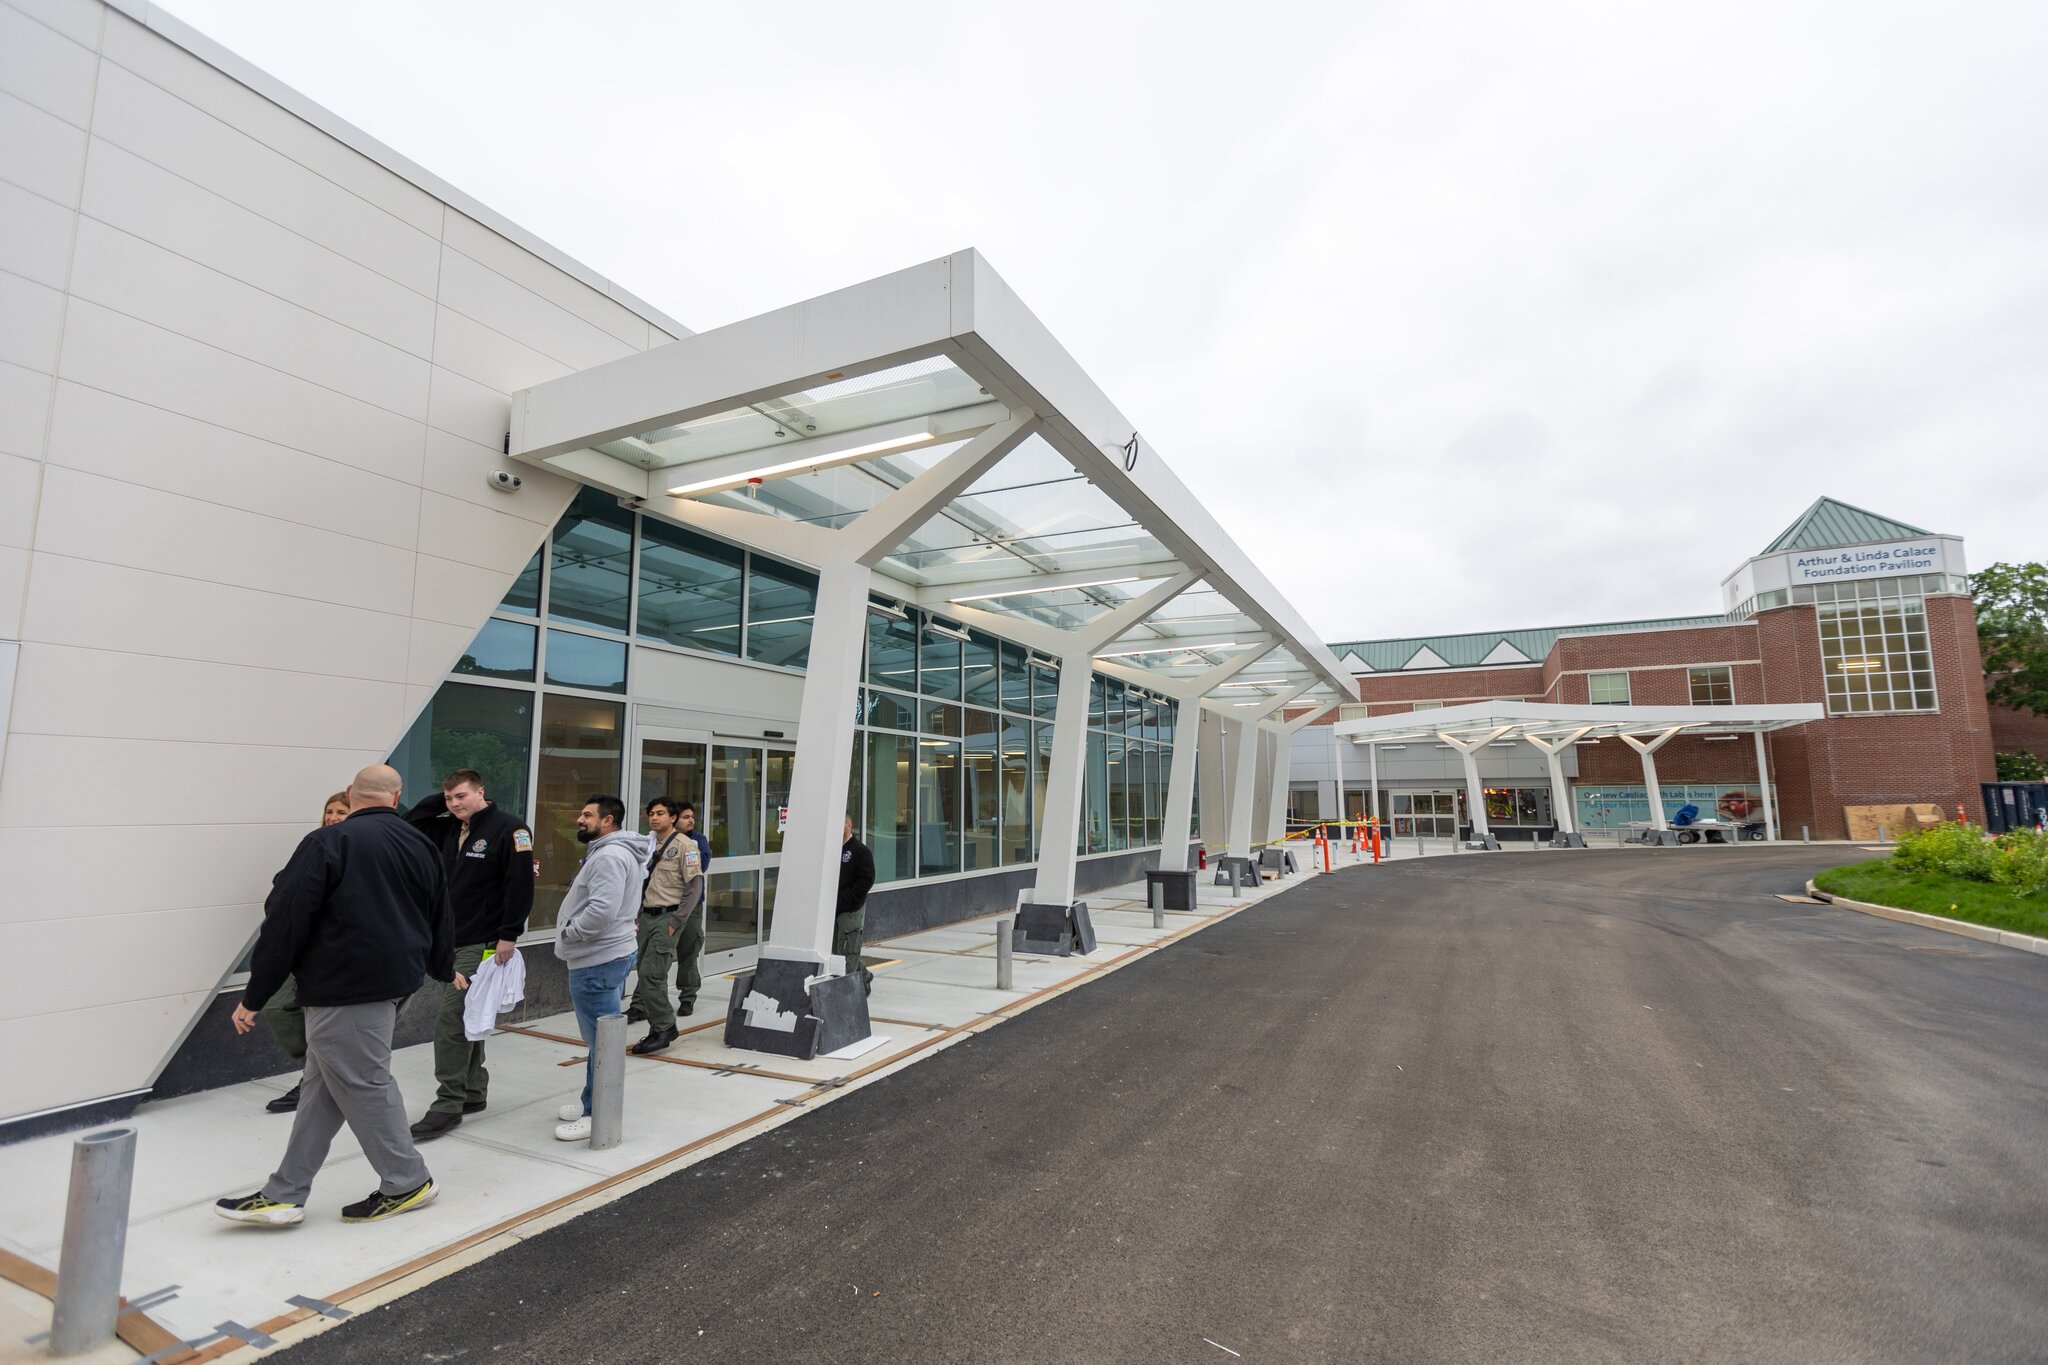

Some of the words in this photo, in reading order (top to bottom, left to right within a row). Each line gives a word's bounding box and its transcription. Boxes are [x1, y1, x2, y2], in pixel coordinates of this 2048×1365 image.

[1797, 556, 1838, 567] Arthur
[1841, 553, 1852, 563] &
[1855, 551, 1890, 562] Linda
[1893, 546, 1936, 558] Calace
[1804, 563, 1876, 577] Foundation
[1880, 558, 1932, 571] Pavilion
[1618, 791, 1649, 799] Cardiac
